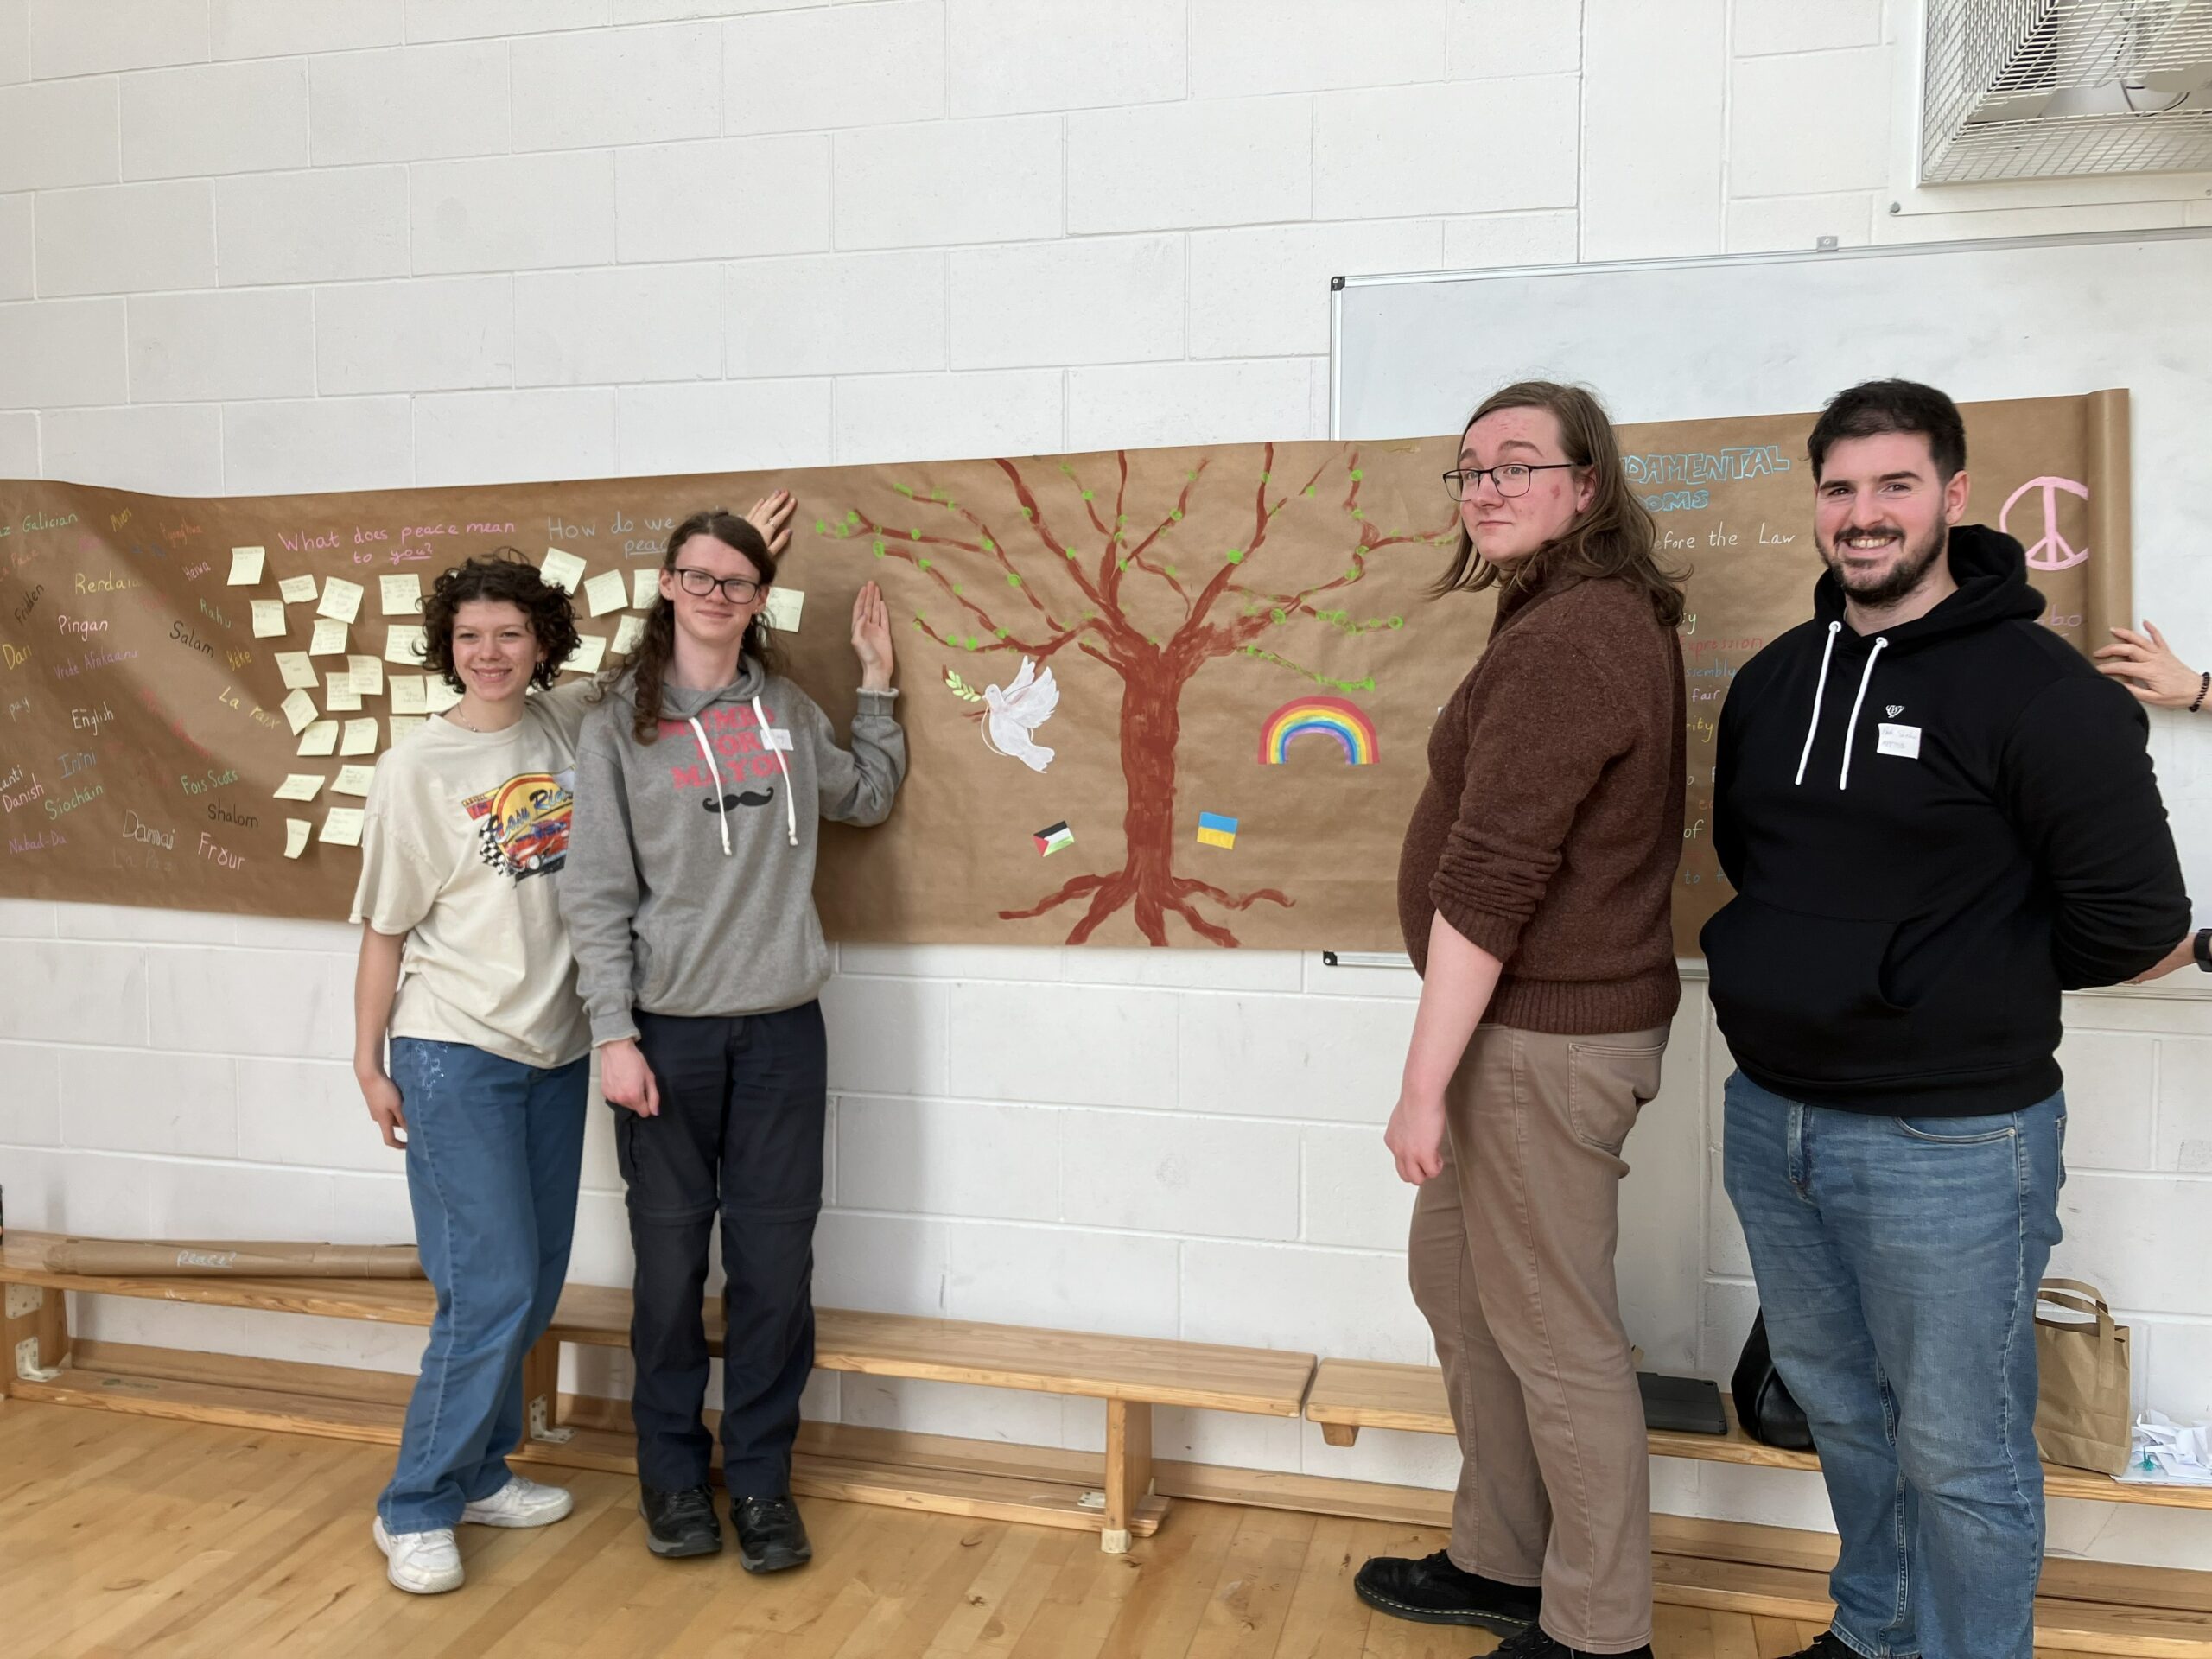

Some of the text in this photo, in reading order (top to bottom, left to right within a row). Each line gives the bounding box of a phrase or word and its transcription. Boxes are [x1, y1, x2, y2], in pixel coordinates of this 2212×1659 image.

[1642, 489, 1710, 512] OMS
[22, 511, 79, 533] Galician
[548, 511, 676, 541] How do we
[1654, 521, 1796, 550] efore the Law
[277, 521, 515, 552] What does peace mean
[624, 537, 668, 560] peac
[353, 542, 433, 566] to you?
[58, 614, 109, 642] Pingan
[169, 620, 215, 658] Salam
[1686, 658, 1738, 679] ssembly
[219, 685, 239, 710] La
[1692, 684, 1721, 702] fair
[71, 701, 114, 736] English
[0, 764, 24, 791] anti
[2, 772, 45, 813] Danish
[123, 809, 176, 850] Damai
[1683, 819, 1705, 839] of
